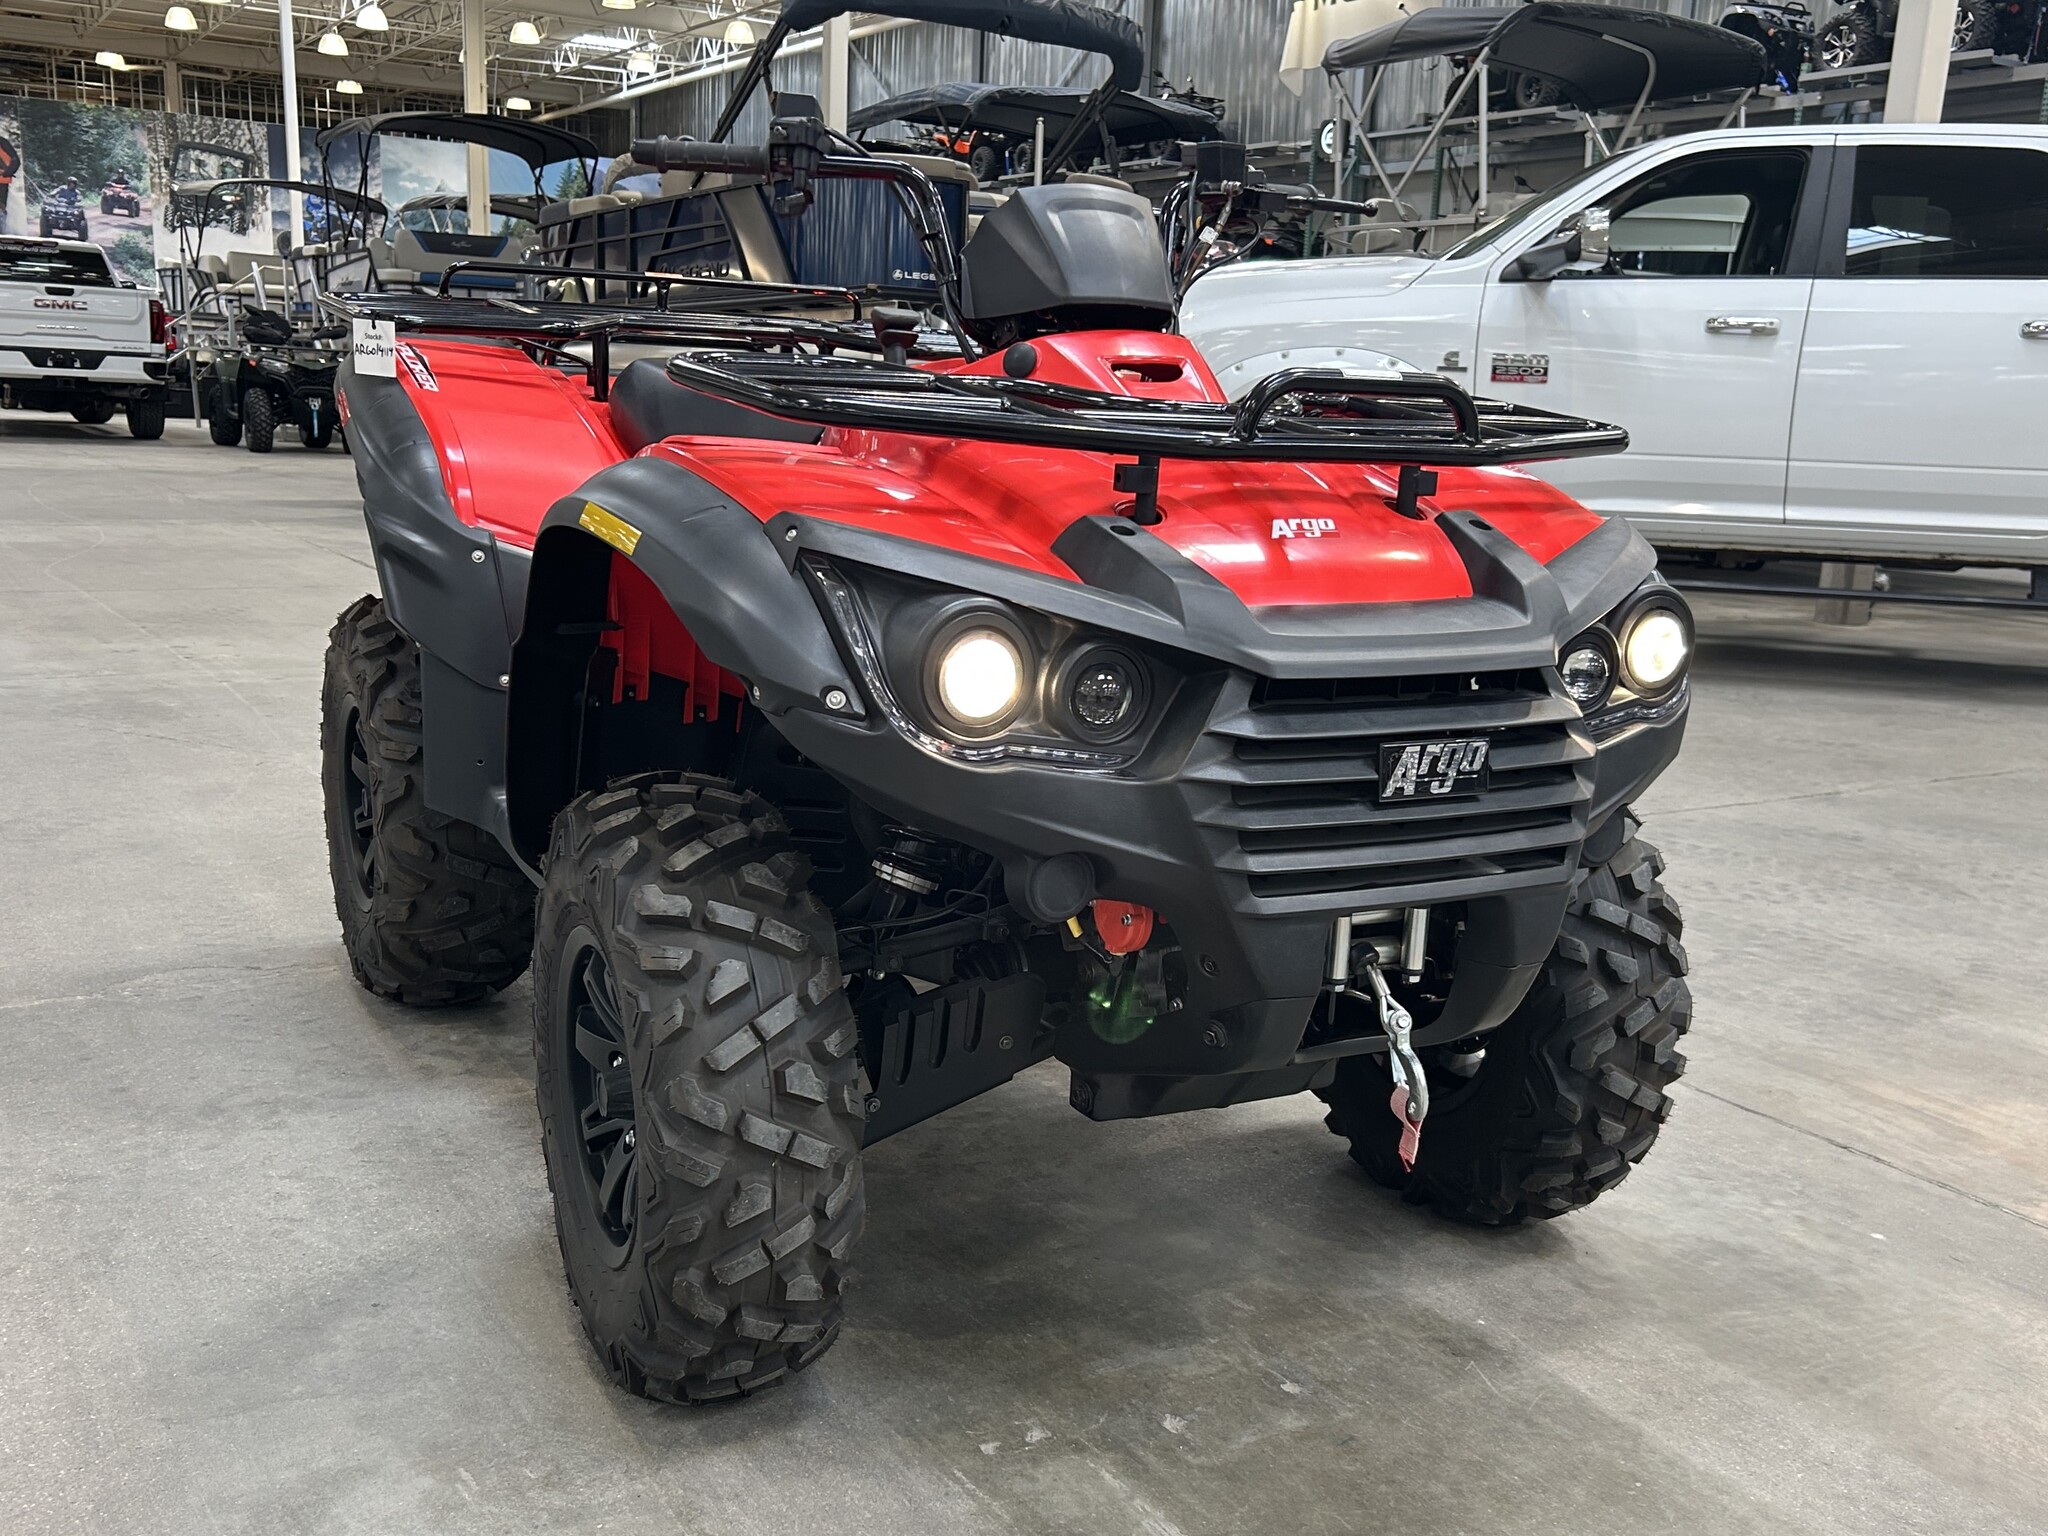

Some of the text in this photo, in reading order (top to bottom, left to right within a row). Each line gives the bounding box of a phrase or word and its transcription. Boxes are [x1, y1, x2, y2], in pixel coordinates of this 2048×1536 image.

[904, 271, 937, 281] LEGE
[34, 298, 88, 311] GMC
[1492, 353, 1550, 365] RAM
[1495, 366, 1545, 376] 2500
[1271, 518, 1337, 539] Argo
[1381, 741, 1489, 798] Argo
